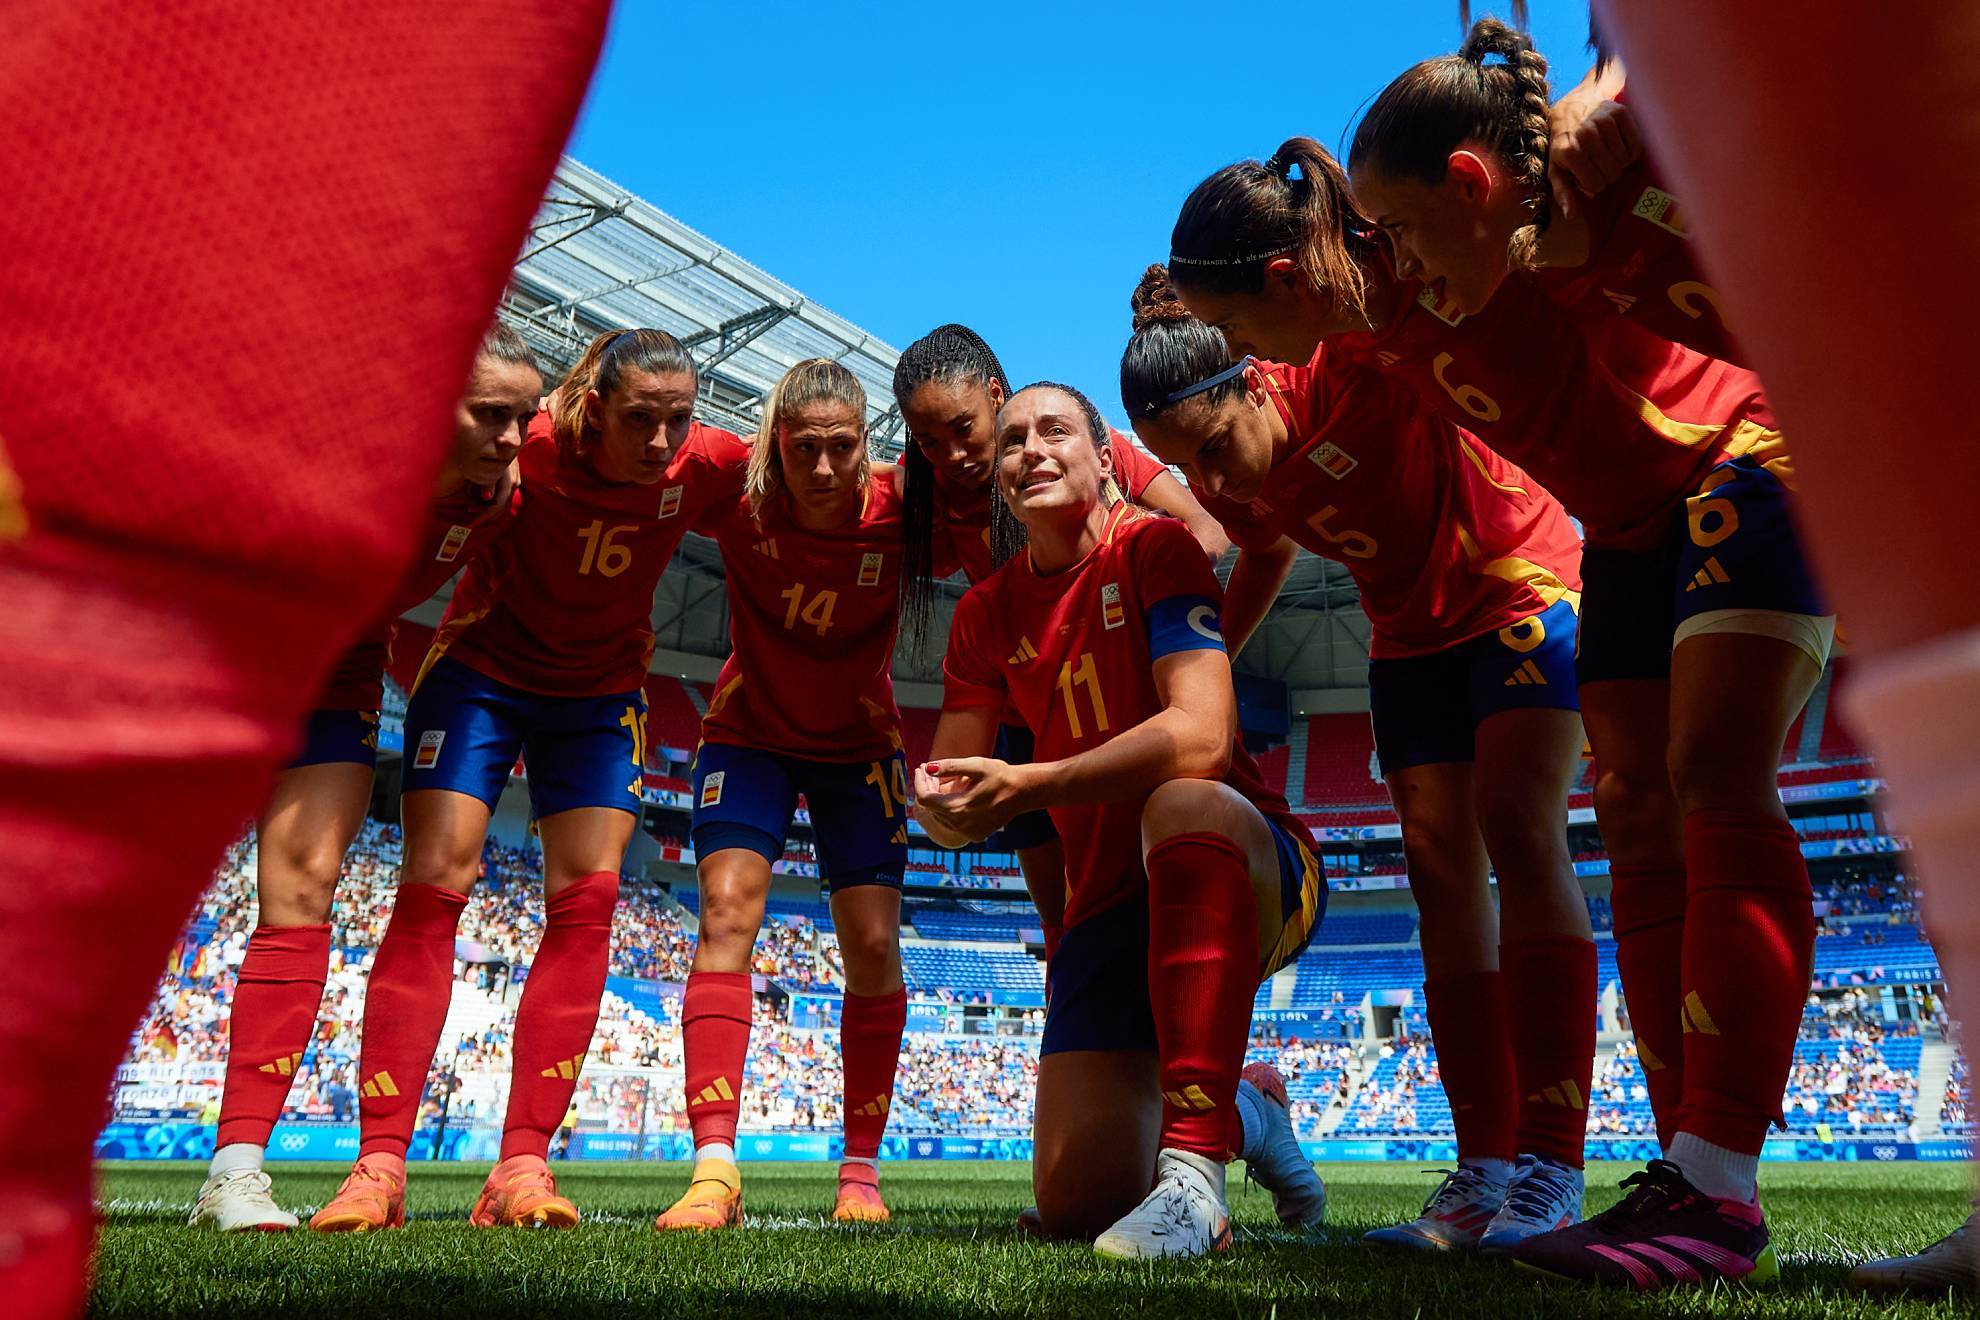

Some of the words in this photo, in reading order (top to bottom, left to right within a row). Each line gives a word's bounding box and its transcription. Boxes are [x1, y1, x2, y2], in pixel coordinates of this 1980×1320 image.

[1246, 254, 1257, 262] DIE
[1433, 351, 1502, 422] 6
[576, 519, 640, 578] 16
[1306, 505, 1378, 559] 5
[781, 582, 838, 637] 14
[1187, 605, 1224, 642] C
[1055, 652, 1110, 739] 11
[1279, 1011, 1309, 1022] 2024
